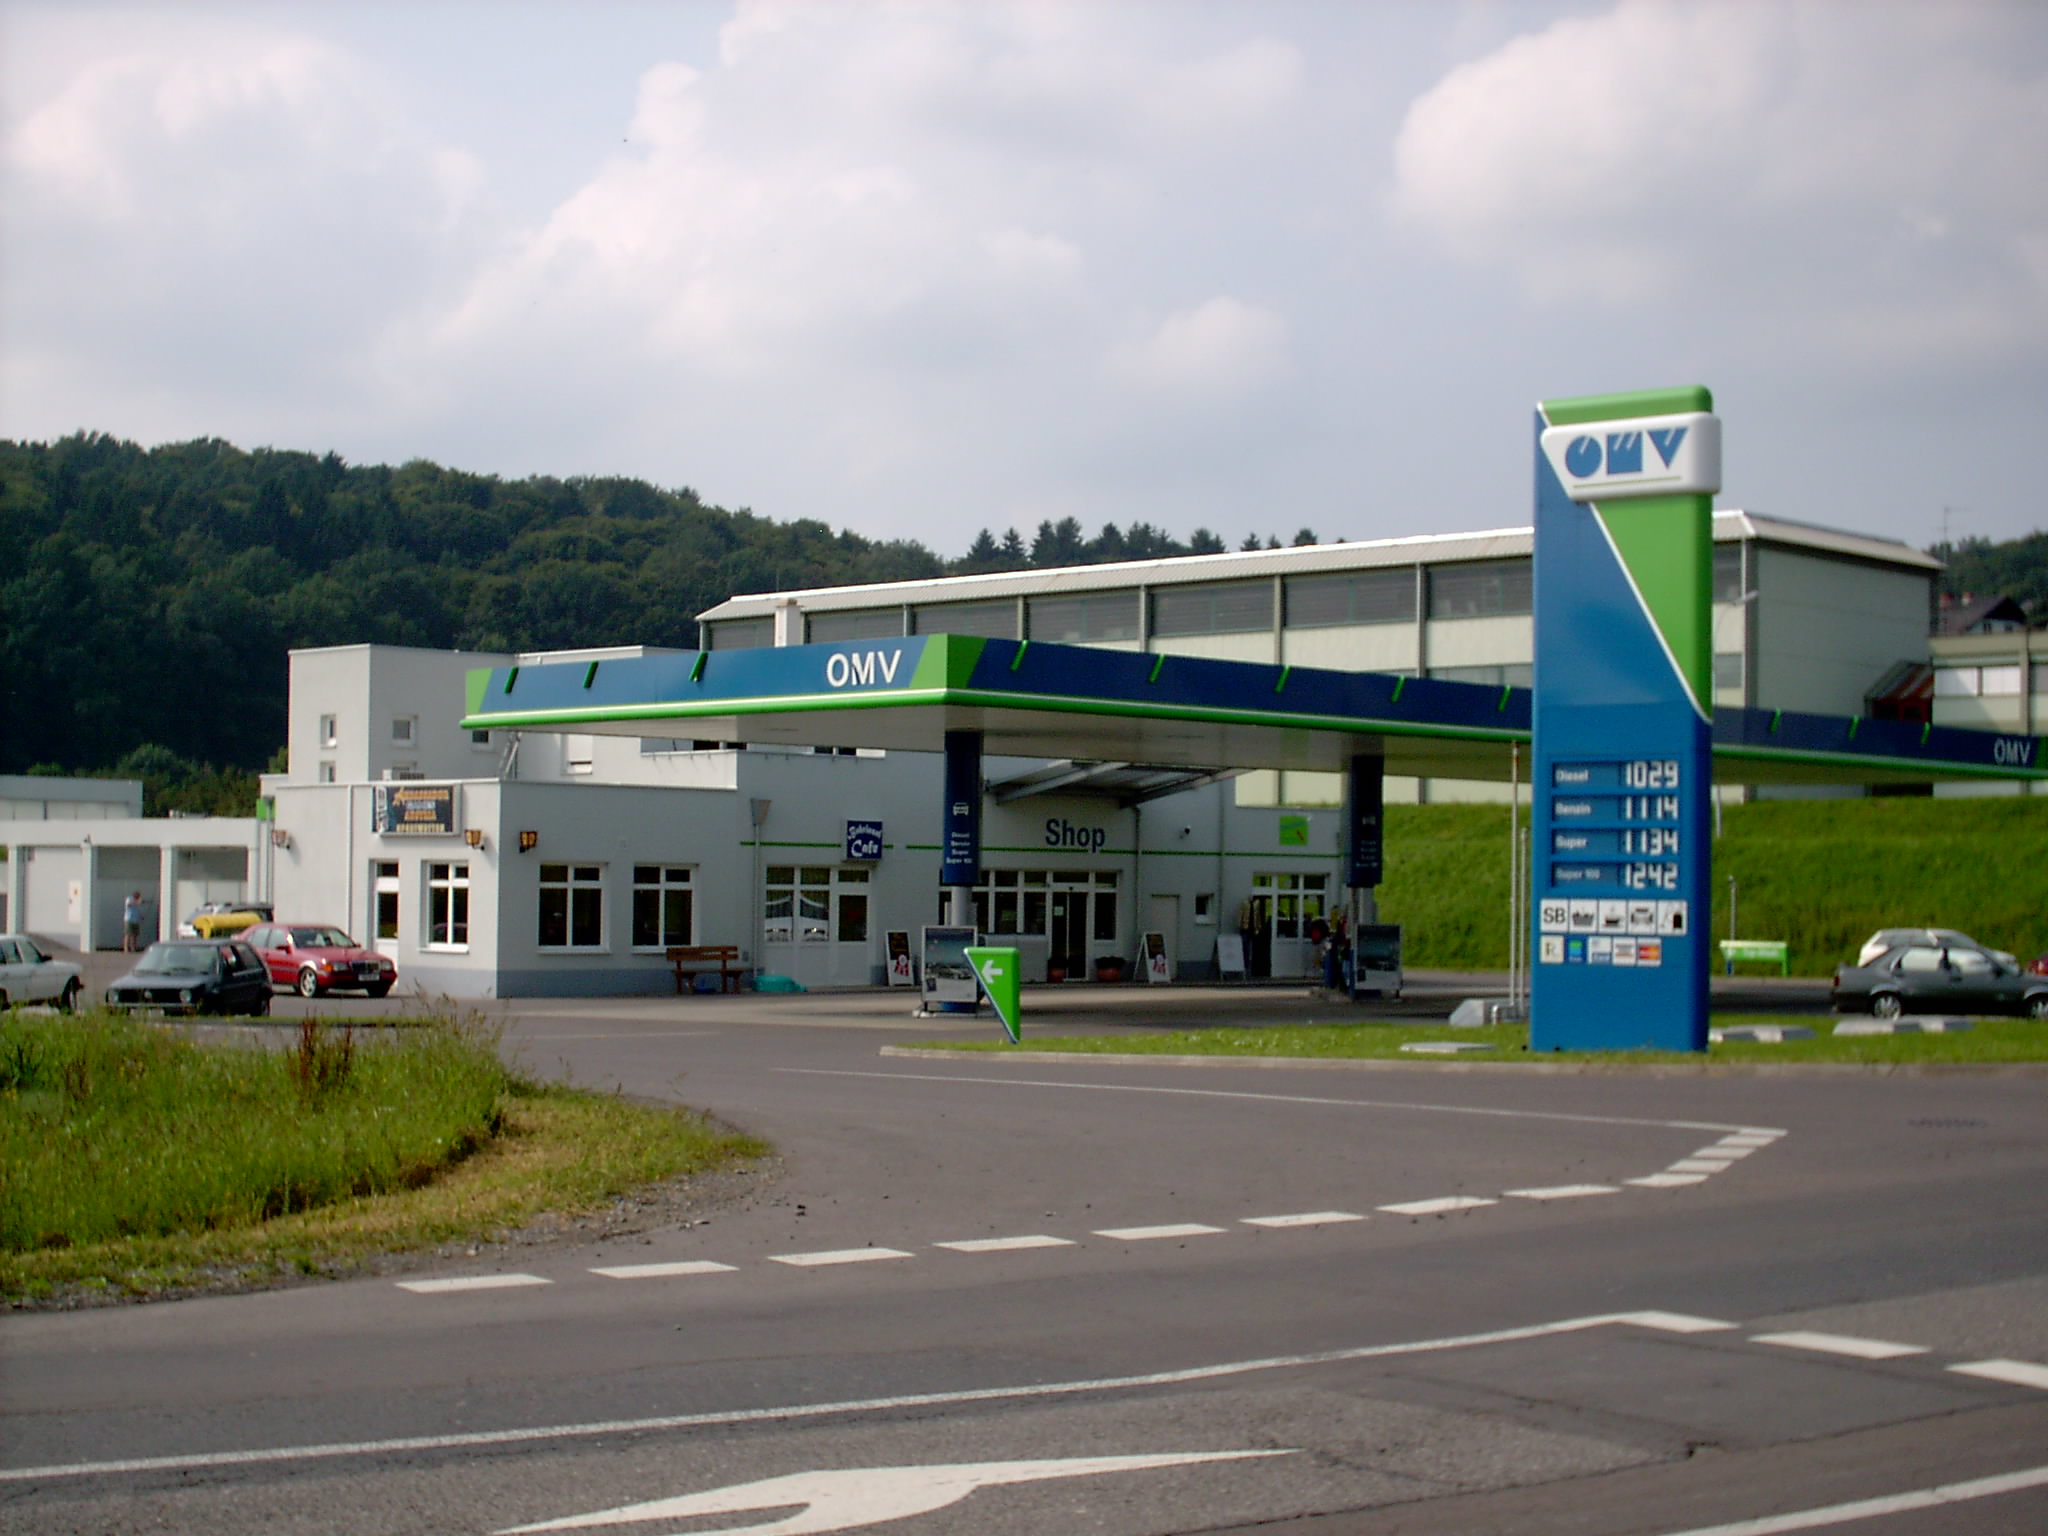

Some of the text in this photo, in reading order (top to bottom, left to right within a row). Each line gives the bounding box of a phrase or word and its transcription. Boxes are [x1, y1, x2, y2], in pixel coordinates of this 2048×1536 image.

[1565, 426, 1688, 478] OMV
[826, 649, 902, 687] OMV
[1993, 737, 2031, 765] OMV
[1555, 760, 1679, 788] Diesel 1029
[1625, 796, 1679, 820] 1114
[1045, 818, 1106, 853] Shop
[1555, 828, 1679, 856] Super 1134
[1625, 862, 1679, 890] 1242
[1543, 907, 1566, 924] SB
